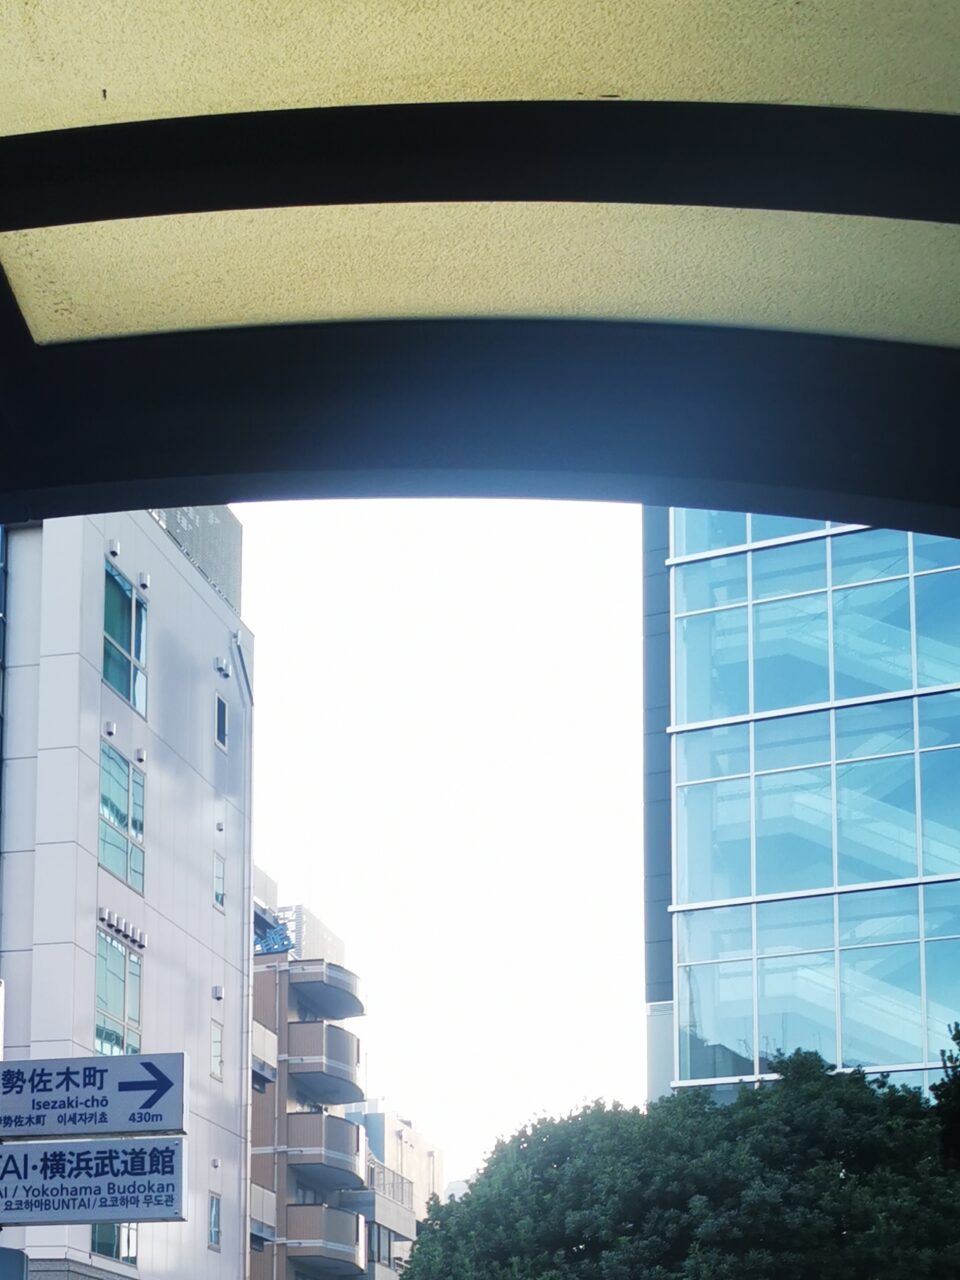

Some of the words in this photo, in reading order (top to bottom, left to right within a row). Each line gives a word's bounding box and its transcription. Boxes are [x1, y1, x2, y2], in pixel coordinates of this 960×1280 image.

[32, 1096, 109, 1110] Isezaki-chō
[128, 1111, 163, 1123] 430m
[23, 1182, 102, 1199] Yokohama
[107, 1180, 176, 1196] Budokan
